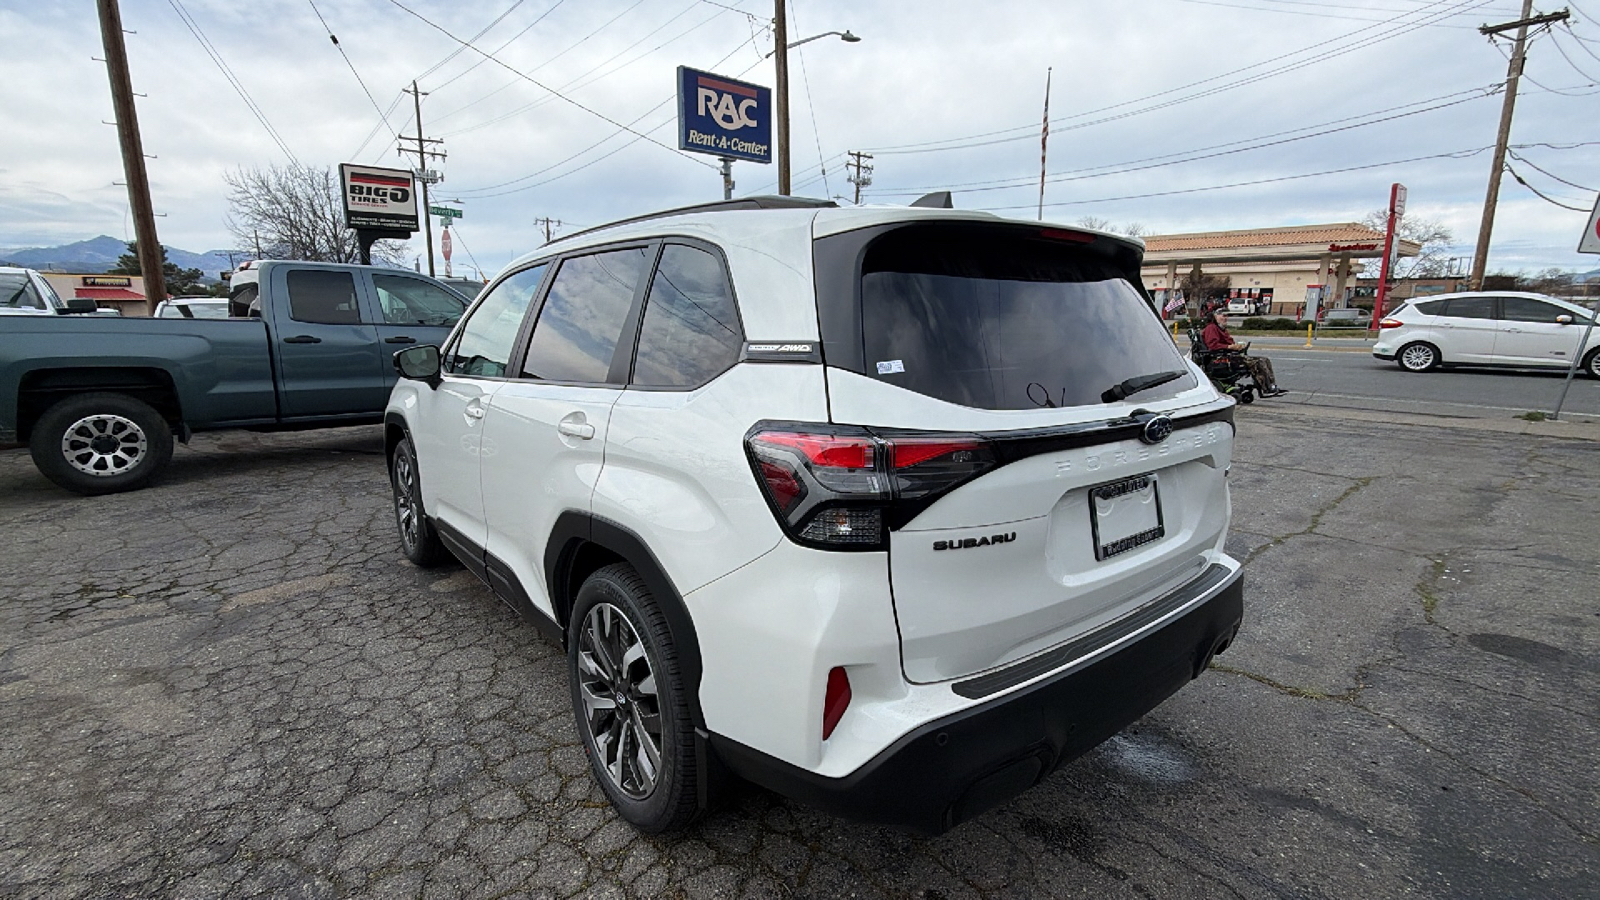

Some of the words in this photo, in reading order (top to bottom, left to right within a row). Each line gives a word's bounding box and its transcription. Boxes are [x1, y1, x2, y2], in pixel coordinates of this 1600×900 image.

[697, 87, 758, 130] RAC
[349, 184, 388, 198] BIG
[349, 195, 388, 204] TIRES
[1328, 243, 1378, 252] Speedway
[778, 344, 812, 353] AWD
[1055, 431, 1218, 477] FORESTER
[932, 531, 1017, 551] SUBARU
